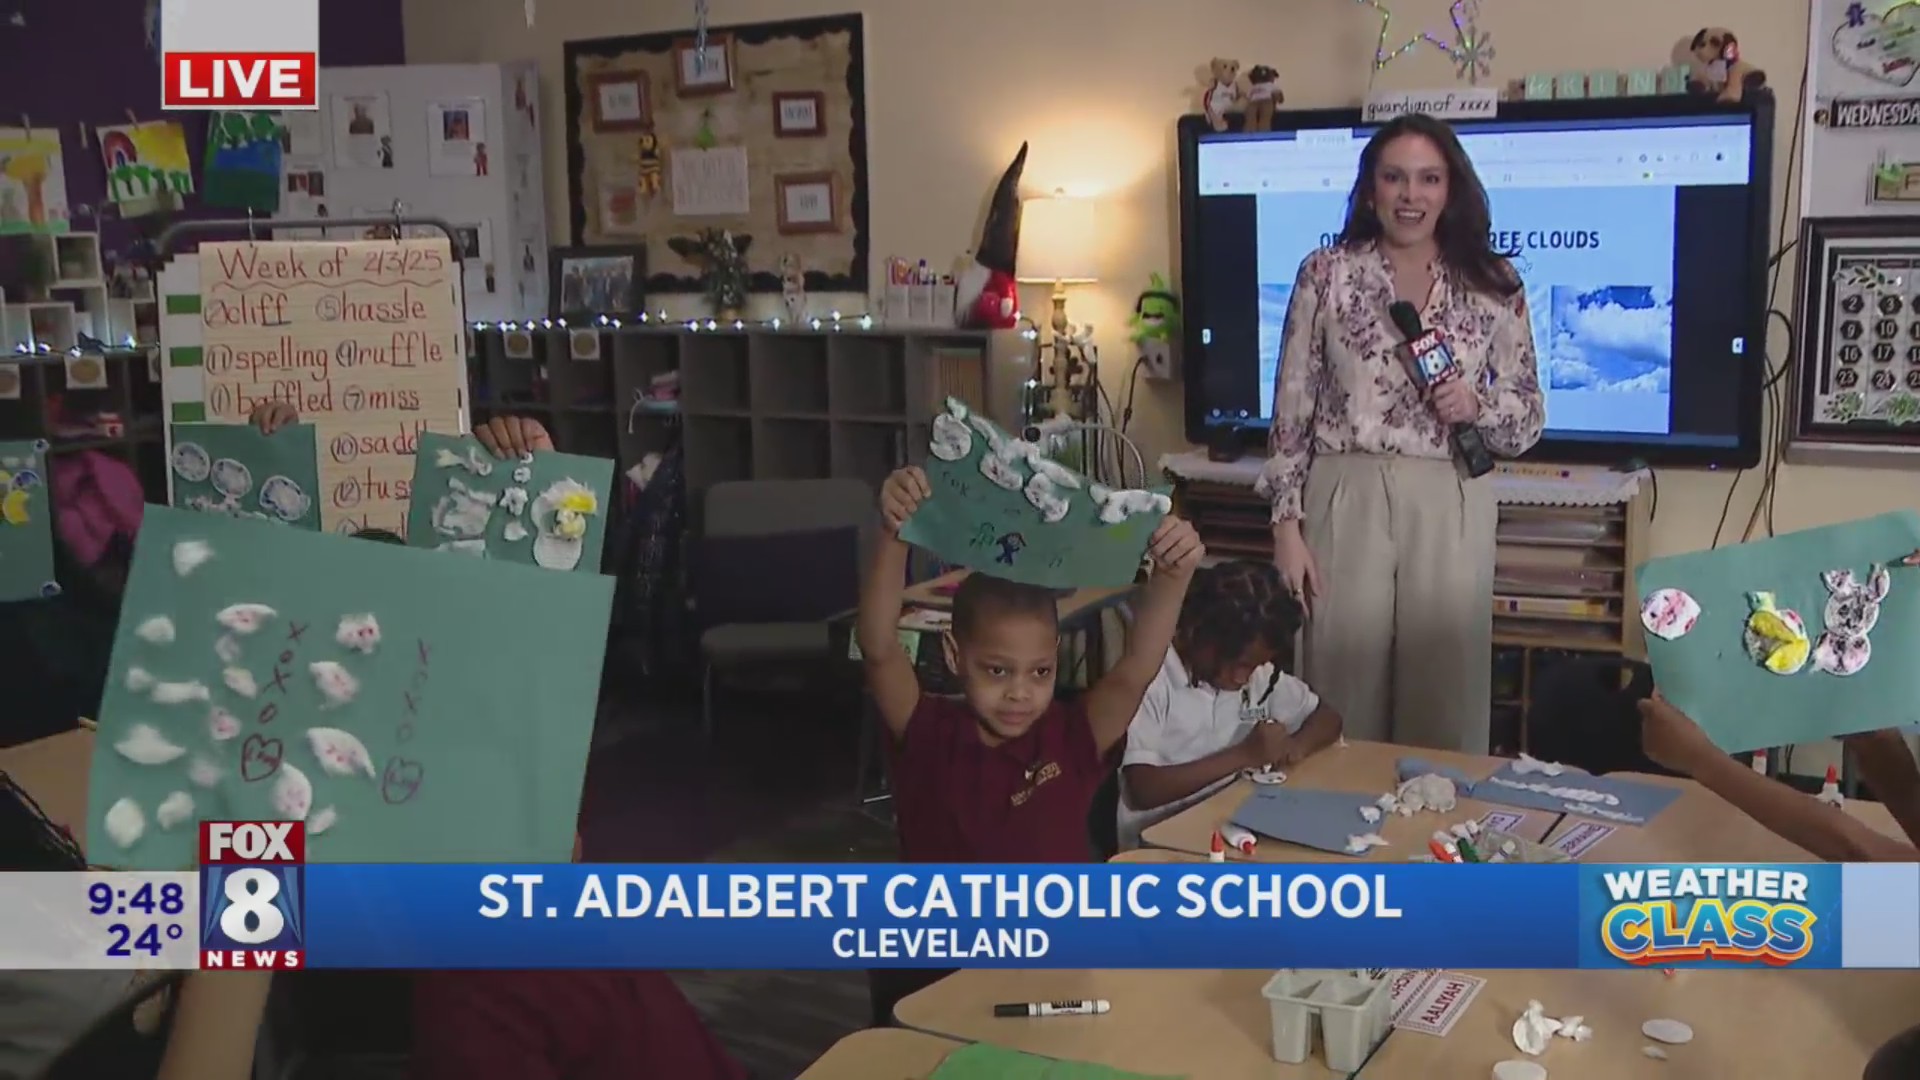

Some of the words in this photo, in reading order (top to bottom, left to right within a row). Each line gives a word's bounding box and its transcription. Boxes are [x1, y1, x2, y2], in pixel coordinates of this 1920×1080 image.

[1836, 103, 1920, 126] WEDNESDA
[1527, 230, 1600, 249] CLOUDS
[217, 247, 307, 280] Week
[318, 247, 348, 278] of
[363, 249, 443, 276] 2/3/25
[229, 292, 290, 326] cliff
[342, 287, 427, 322] hassle
[1880, 322, 1895, 336] 10
[359, 331, 443, 367] ruffle
[1411, 331, 1440, 356] FOX
[1844, 347, 1859, 361] 16
[1877, 345, 1892, 359] 17
[235, 335, 329, 384] spelling
[1424, 349, 1447, 375] 8
[369, 390, 419, 410] miss
[1421, 982, 1464, 1024] AALIYAH
